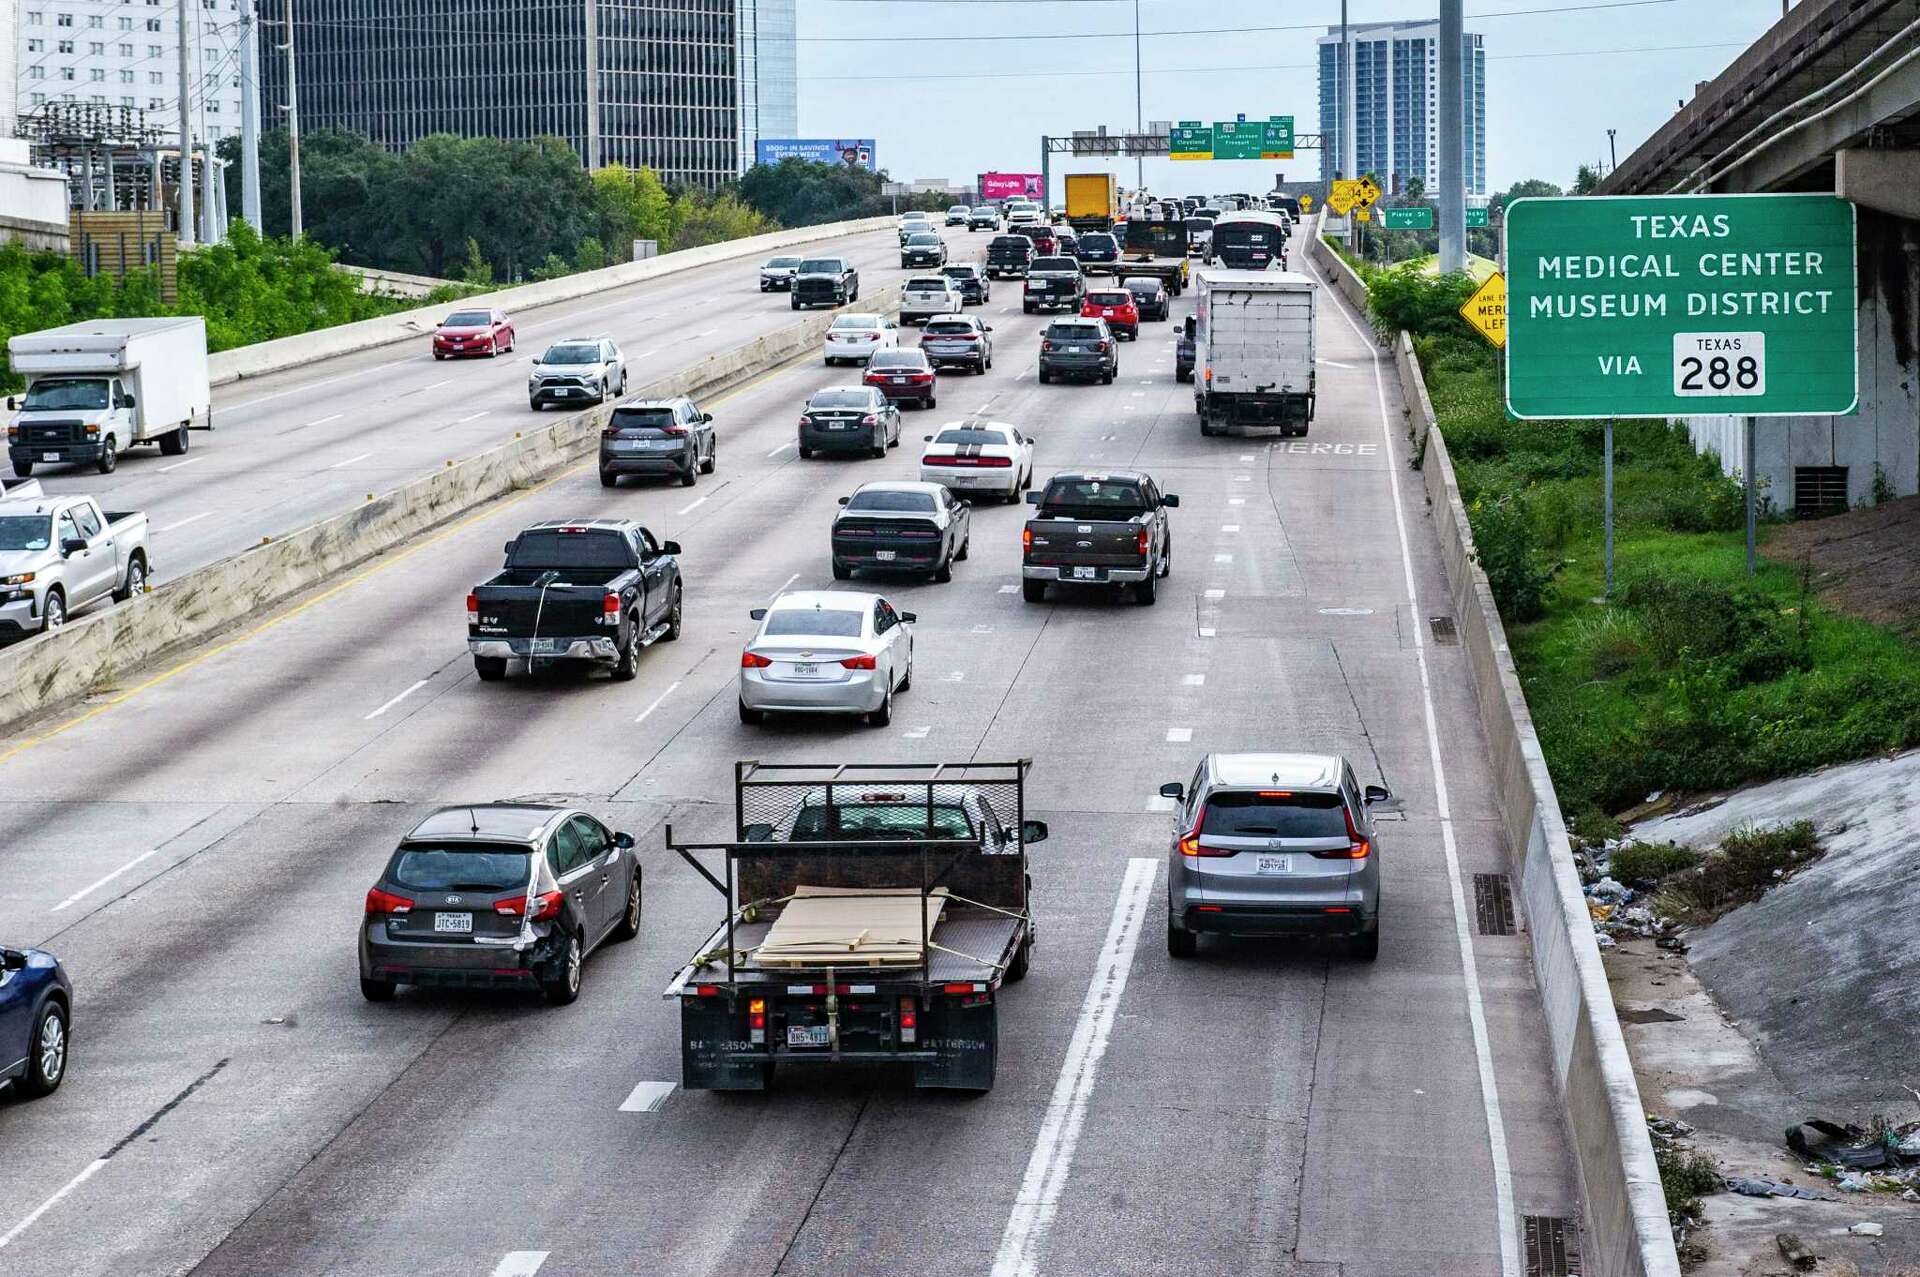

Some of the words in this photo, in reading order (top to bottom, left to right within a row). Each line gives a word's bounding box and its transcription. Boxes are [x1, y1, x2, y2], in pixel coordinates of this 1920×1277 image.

[1630, 214, 1730, 239] TEXAS
[1538, 254, 1680, 279] MEDICAL
[1698, 252, 1823, 276] CENTER
[1530, 293, 1667, 318] MUSEUM
[1687, 290, 1833, 316] DISTRICT
[1484, 319, 1506, 329] LEF
[1696, 338, 1742, 351] TEXAS
[1598, 355, 1642, 375] VIA
[1680, 356, 1759, 390] 288
